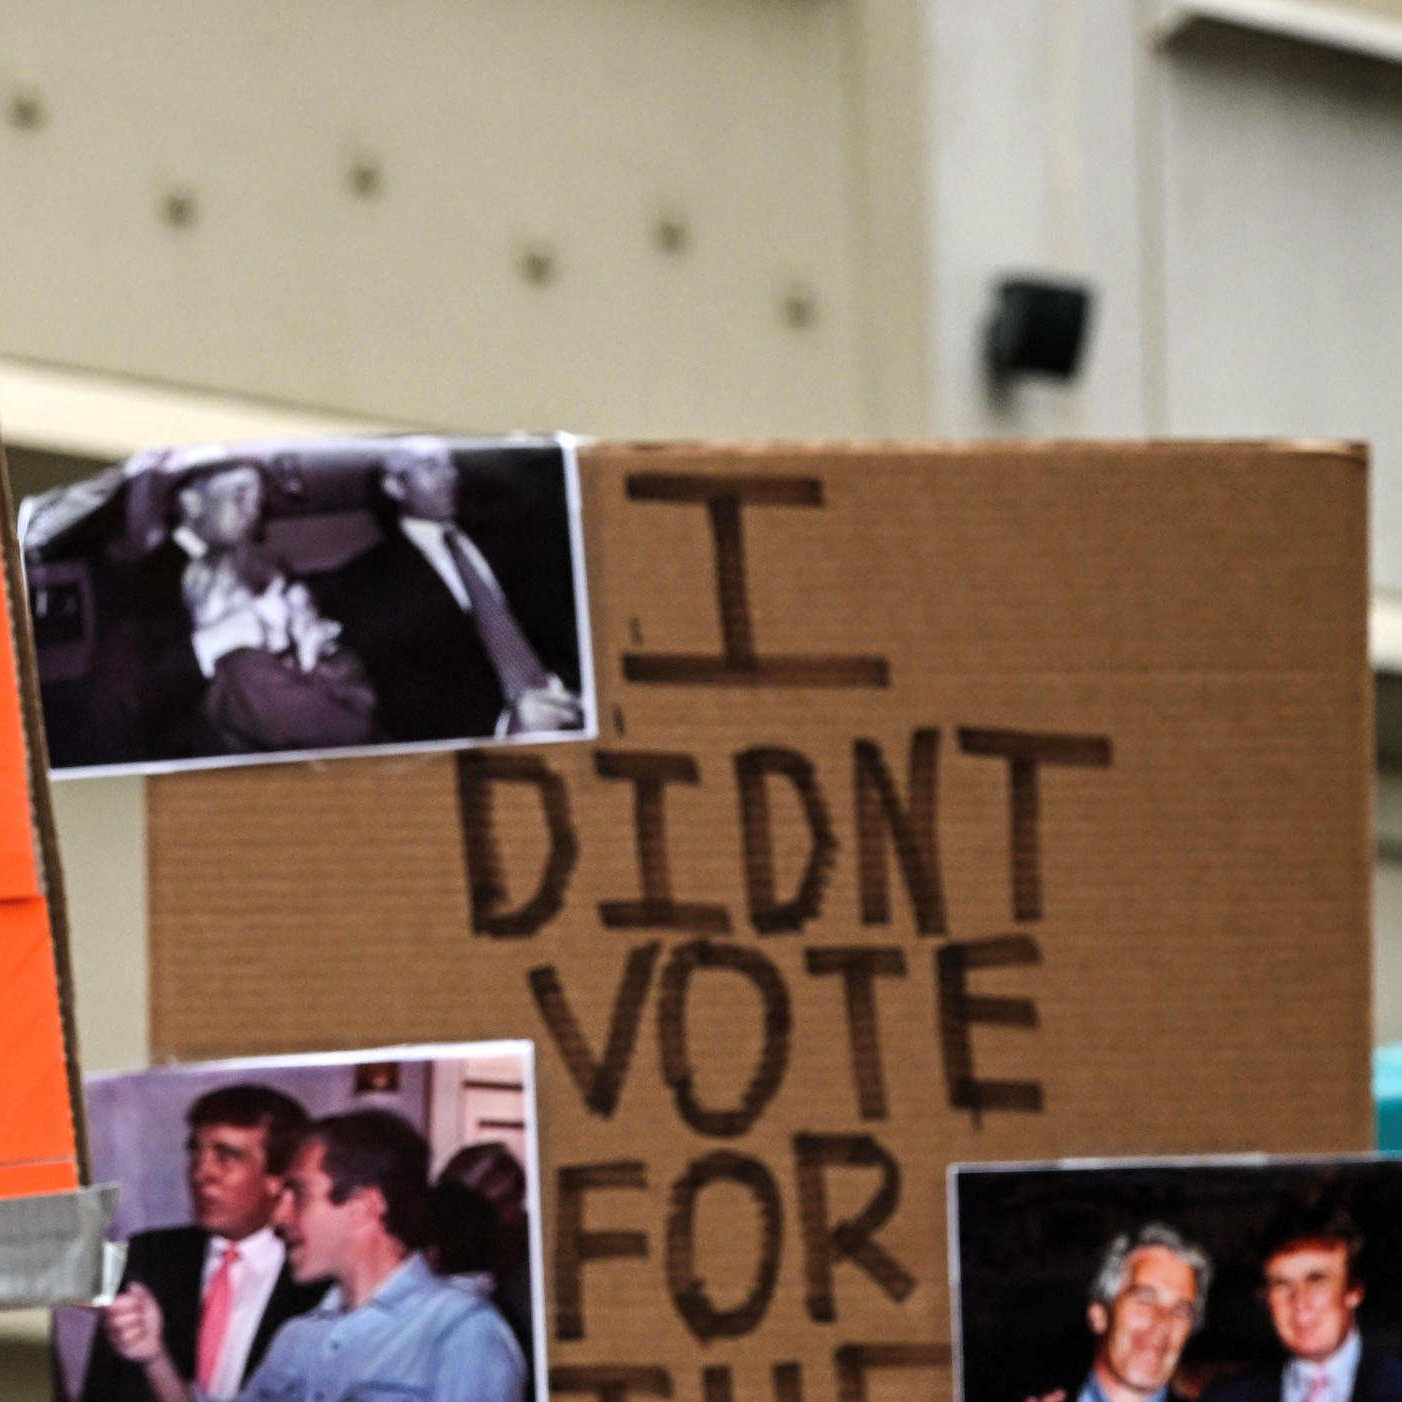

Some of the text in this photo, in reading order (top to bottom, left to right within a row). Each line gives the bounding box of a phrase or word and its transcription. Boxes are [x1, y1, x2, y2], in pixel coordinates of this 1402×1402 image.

[621, 469, 891, 690] I
[454, 726, 1114, 939] DIDNT
[526, 934, 1046, 1140] VOTE
[554, 1131, 920, 1349] FOR
